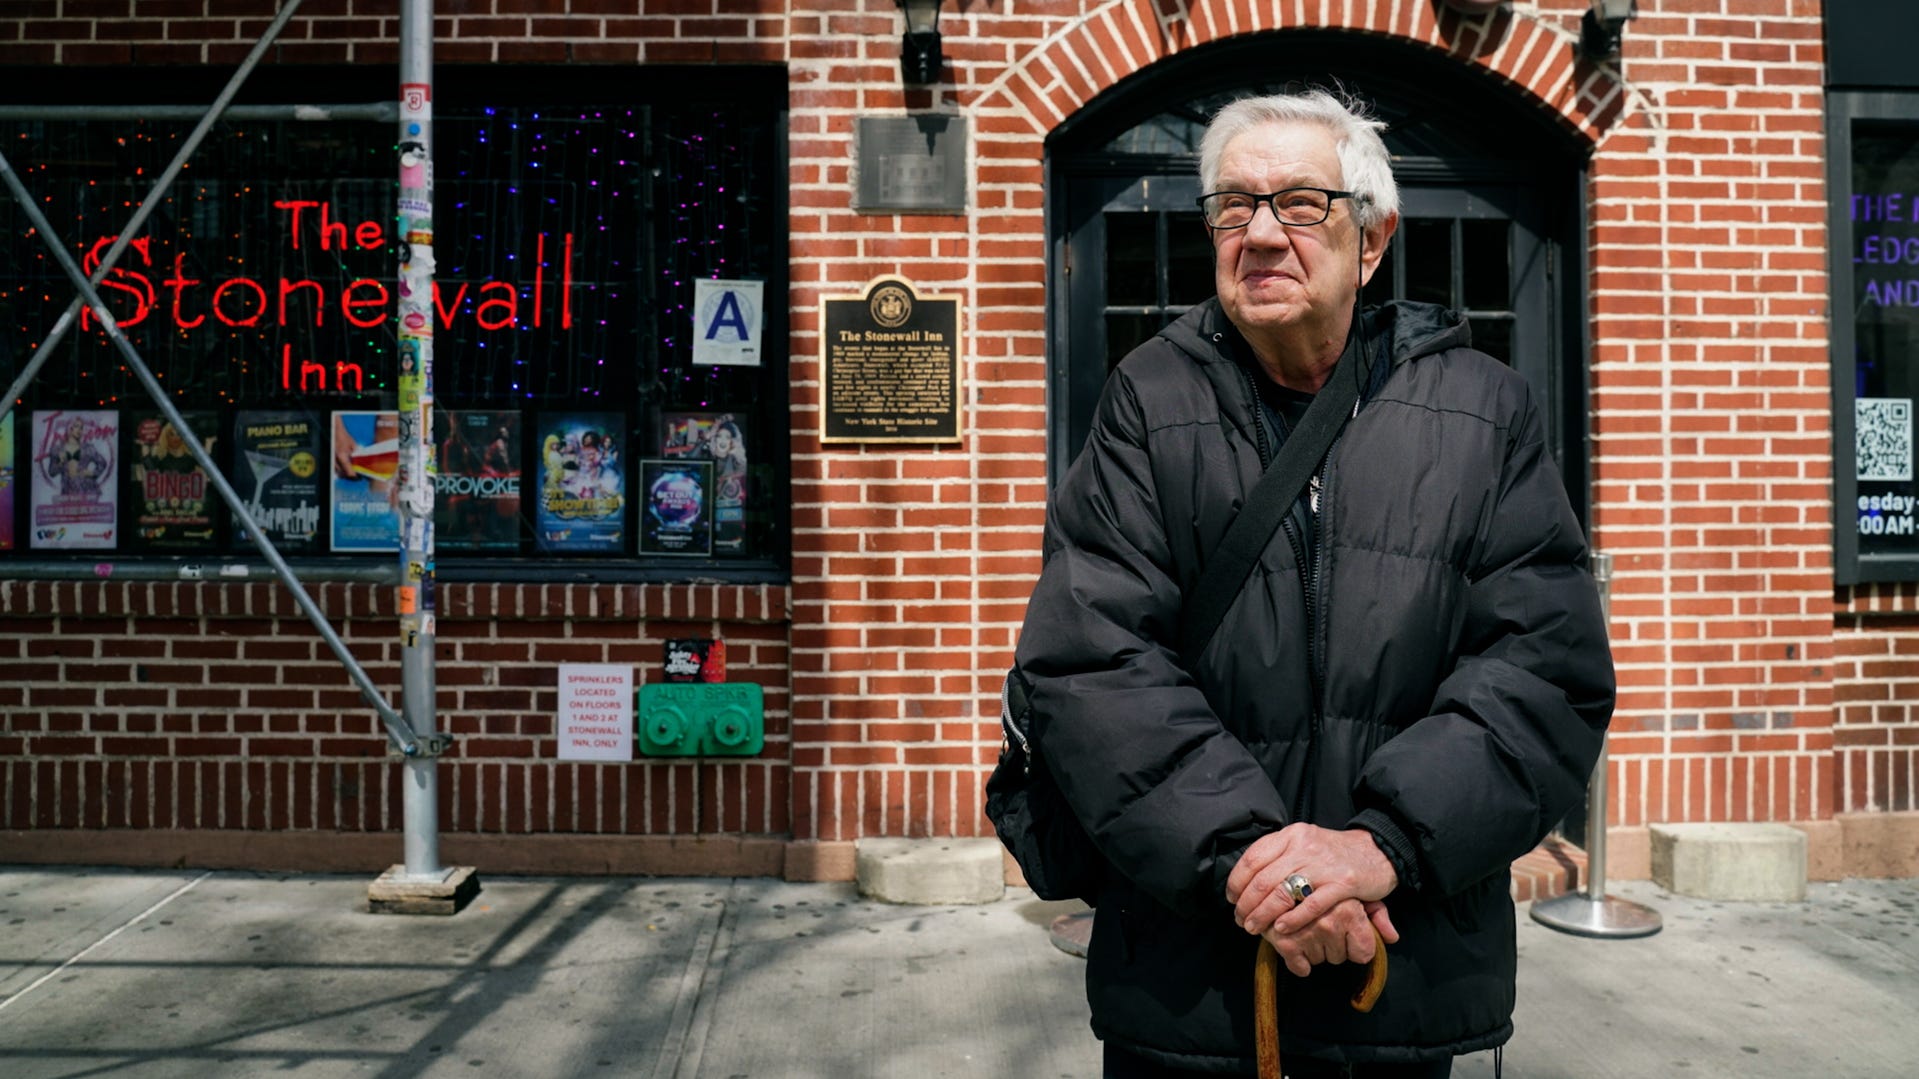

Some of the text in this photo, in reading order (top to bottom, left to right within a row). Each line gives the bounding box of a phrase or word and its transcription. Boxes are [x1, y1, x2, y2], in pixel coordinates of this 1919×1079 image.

[273, 200, 386, 250] The
[705, 291, 750, 342] A
[839, 330, 943, 342] The Stonewall Inn
[283, 343, 362, 391] Inn
[247, 425, 282, 438] PIANO
[145, 470, 205, 500] BINGO
[435, 477, 520, 497] PROVOKE
[567, 675, 624, 684] SPRINKLERS
[574, 688, 616, 697] LOCATED
[569, 701, 622, 709] ON FLOORS
[608, 714, 618, 722] AT
[568, 726, 622, 735] STONEWALL
[594, 739, 618, 748] ONLY
